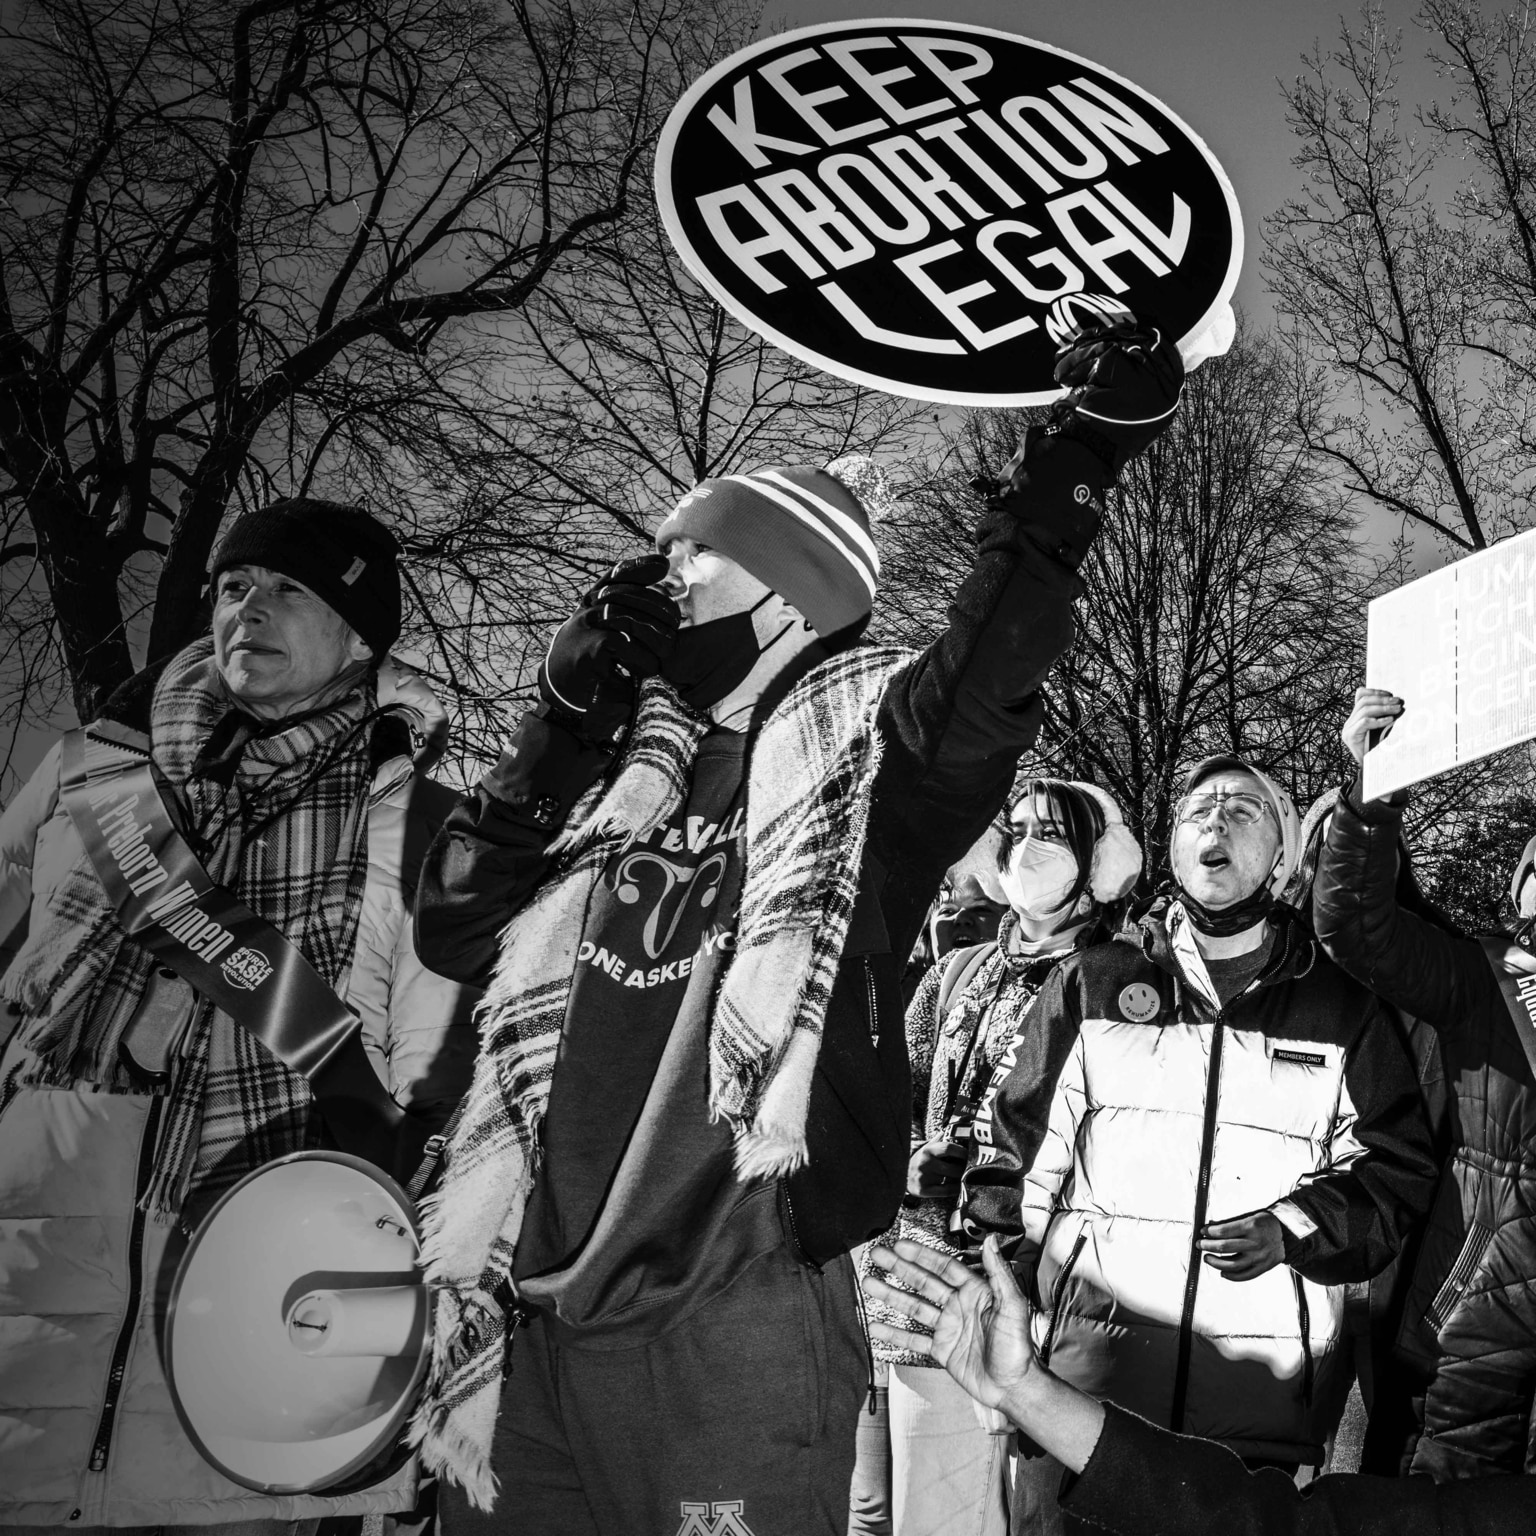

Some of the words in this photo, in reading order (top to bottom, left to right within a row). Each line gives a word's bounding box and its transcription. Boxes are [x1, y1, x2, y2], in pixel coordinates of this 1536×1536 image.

[706, 36, 994, 169] KEEP
[695, 77, 1171, 294] ABORTION
[817, 181, 1192, 355] LEGAL
[97, 793, 168, 897] Preborn
[145, 880, 235, 963] Women
[220, 962, 257, 992] REVOLUTION
[226, 952, 268, 987] SASH
[577, 941, 627, 983] ONE
[703, 930, 738, 957] YO
[1125, 1000, 1156, 1018] REHUMANIZE
[973, 1033, 1026, 1166] MEMBE
[1278, 1051, 1306, 1061] MEMBERS
[1306, 1055, 1322, 1063] ONLY
